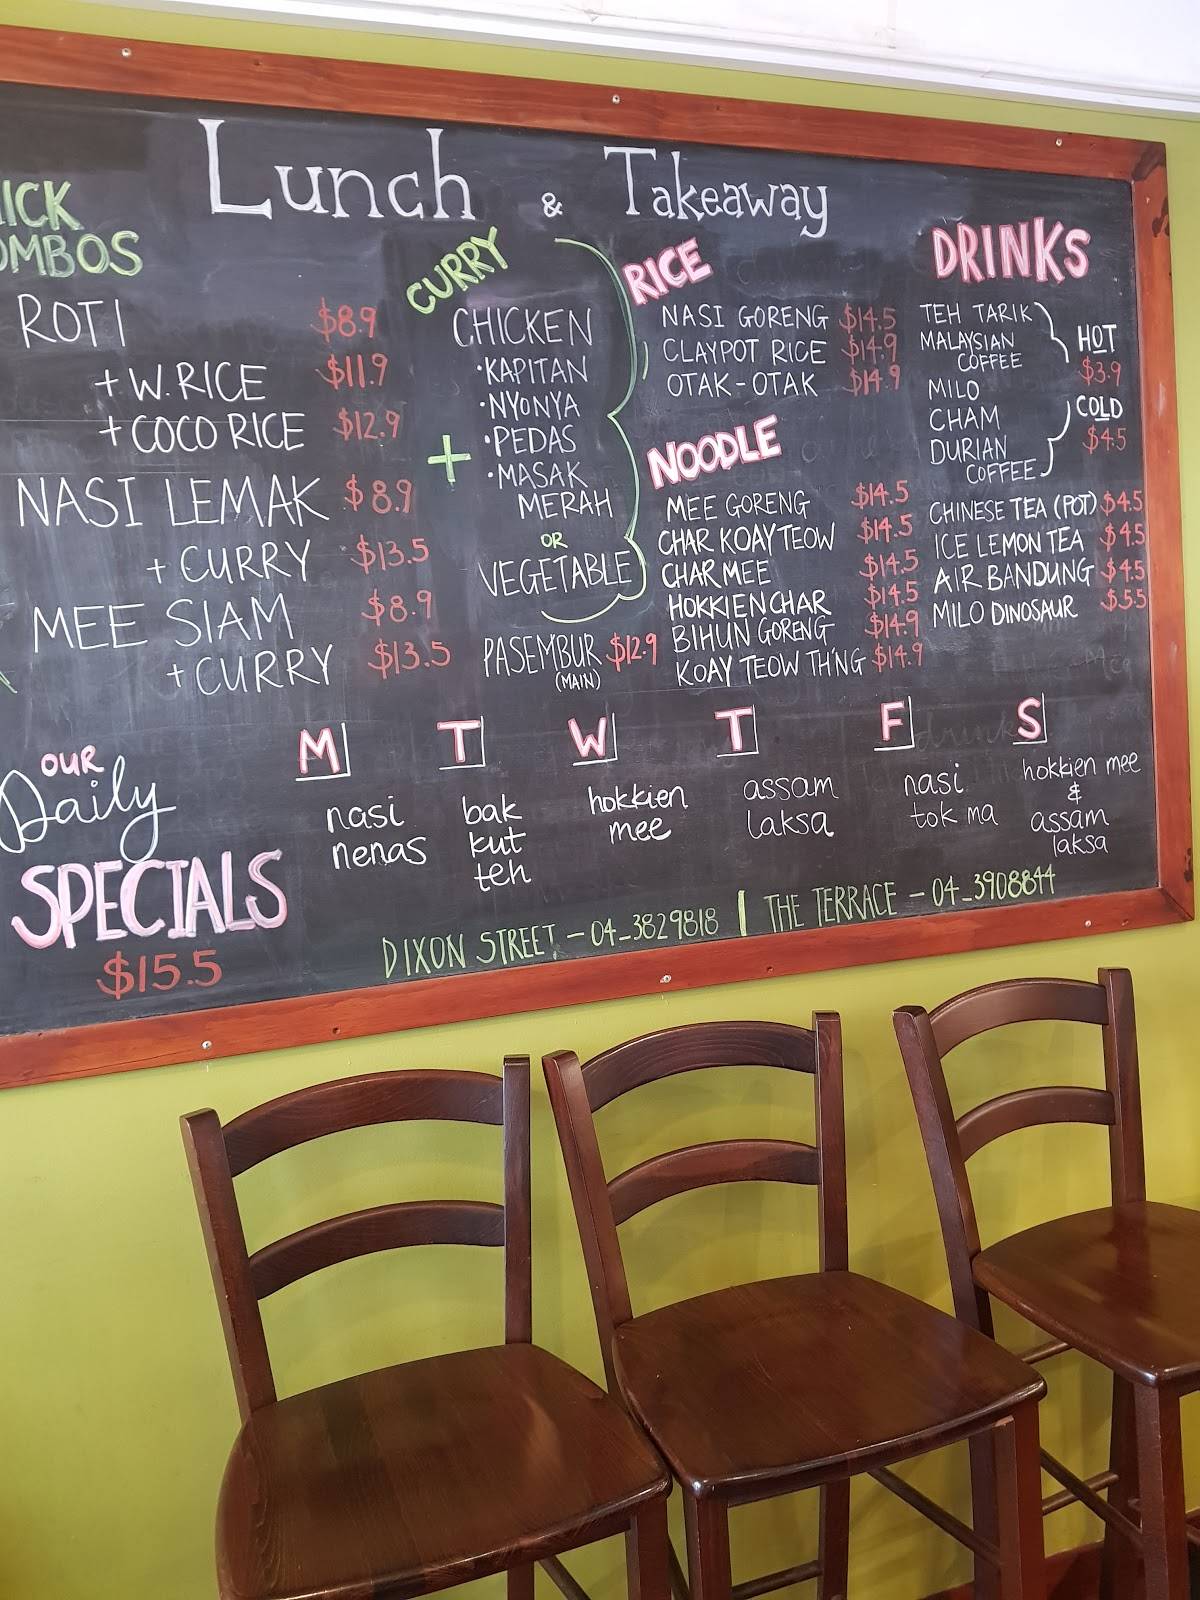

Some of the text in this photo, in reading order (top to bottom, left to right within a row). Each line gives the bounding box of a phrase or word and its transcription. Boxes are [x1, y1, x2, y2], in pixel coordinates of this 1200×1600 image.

[198, 118, 830, 239] Lunch & Takeaway
[0, 180, 85, 231] ICK
[931, 216, 1092, 284] DRINKS
[405, 226, 508, 315] CURRY
[621, 236, 714, 305] RICE
[17, 293, 377, 348] ROTI $8.9
[452, 306, 593, 348] CHICKEN
[662, 302, 897, 333] NASI GORENG $14.5
[919, 303, 1033, 325] TEH TARIK
[663, 333, 897, 366] CLAYPOT RICE $14.9
[919, 330, 1015, 355] MALAYSIAN
[1077, 323, 1117, 352] HOT
[315, 353, 388, 390] $11.9
[483, 356, 589, 384] KAPITAN
[843, 364, 901, 396] $14.9
[957, 352, 1023, 372] COFFEE
[1079, 355, 1121, 386] $3.9
[489, 392, 581, 421] NYONYA
[928, 377, 980, 402] MILO
[1076, 395, 1124, 419] COLD
[132, 414, 217, 453] COCO
[227, 412, 305, 451] RICE
[332, 408, 400, 441] $12.9
[929, 404, 1001, 432] CHAM
[493, 424, 576, 457] PEDAS
[646, 414, 782, 490] NOODLE
[930, 434, 1007, 465] DURIAN
[1082, 424, 1127, 454] $4.5
[498, 461, 588, 489] MASAK
[966, 458, 1037, 484] COFFEE
[16, 476, 143, 528] NASI
[165, 473, 330, 528] LEMAK
[518, 488, 614, 520] MERAH
[666, 479, 909, 522] MEE GORENG $14.5
[929, 490, 1143, 525] CHINESE TEA (POT) $4.5
[540, 532, 568, 549] OR
[658, 527, 714, 556] CHAR
[856, 513, 913, 544] $14.5
[934, 521, 1146, 560] ICE LEMON TEA $4.5
[180, 539, 312, 584] CURRY
[350, 534, 430, 575] $13.5
[478, 551, 632, 597] VEGETABLE
[661, 549, 919, 589] CHAR MEE $14.5
[934, 557, 1146, 594] AIR BANDUNG $4.5
[864, 580, 919, 610] $14.5
[933, 588, 1147, 628] MILO DINOSAUR $5.5
[33, 590, 432, 654] MEE SIAM $8.9
[671, 609, 919, 653] BIHUN GORENG $14.9
[196, 643, 334, 697] CURRY
[368, 638, 451, 680] $13.5
[484, 632, 657, 677] PASEMBUR $12.9
[675, 655, 732, 688] KOAY
[739, 650, 799, 685] TEOW
[872, 642, 924, 673] $14.9
[556, 671, 601, 693] (MAIN)
[713, 705, 753, 752] T
[879, 700, 905, 742] F
[1015, 696, 1042, 741] S
[298, 727, 342, 774] M
[436, 719, 482, 763] T
[567, 716, 607, 759] W
[903, 763, 965, 797] nasi
[1022, 751, 1141, 782] hokkien mee
[588, 784, 688, 816] hokkien
[742, 775, 839, 801] assam
[0, 755, 177, 864] Daily
[326, 796, 405, 833] nasi
[461, 793, 523, 825] bak
[747, 809, 834, 840] laksa
[910, 801, 999, 830] tok ma
[1030, 805, 1110, 833] assam
[469, 826, 527, 858] kut
[609, 816, 672, 844] mee
[1053, 833, 1108, 857] laksa
[331, 836, 427, 871] nenas
[473, 858, 532, 892] teh
[10, 848, 289, 950] SPECIALS
[764, 892, 805, 934] THE
[811, 881, 898, 927] TERRACE
[382, 932, 466, 980] DIXON
[475, 923, 556, 966] STREET
[96, 948, 223, 1000] $15.5
